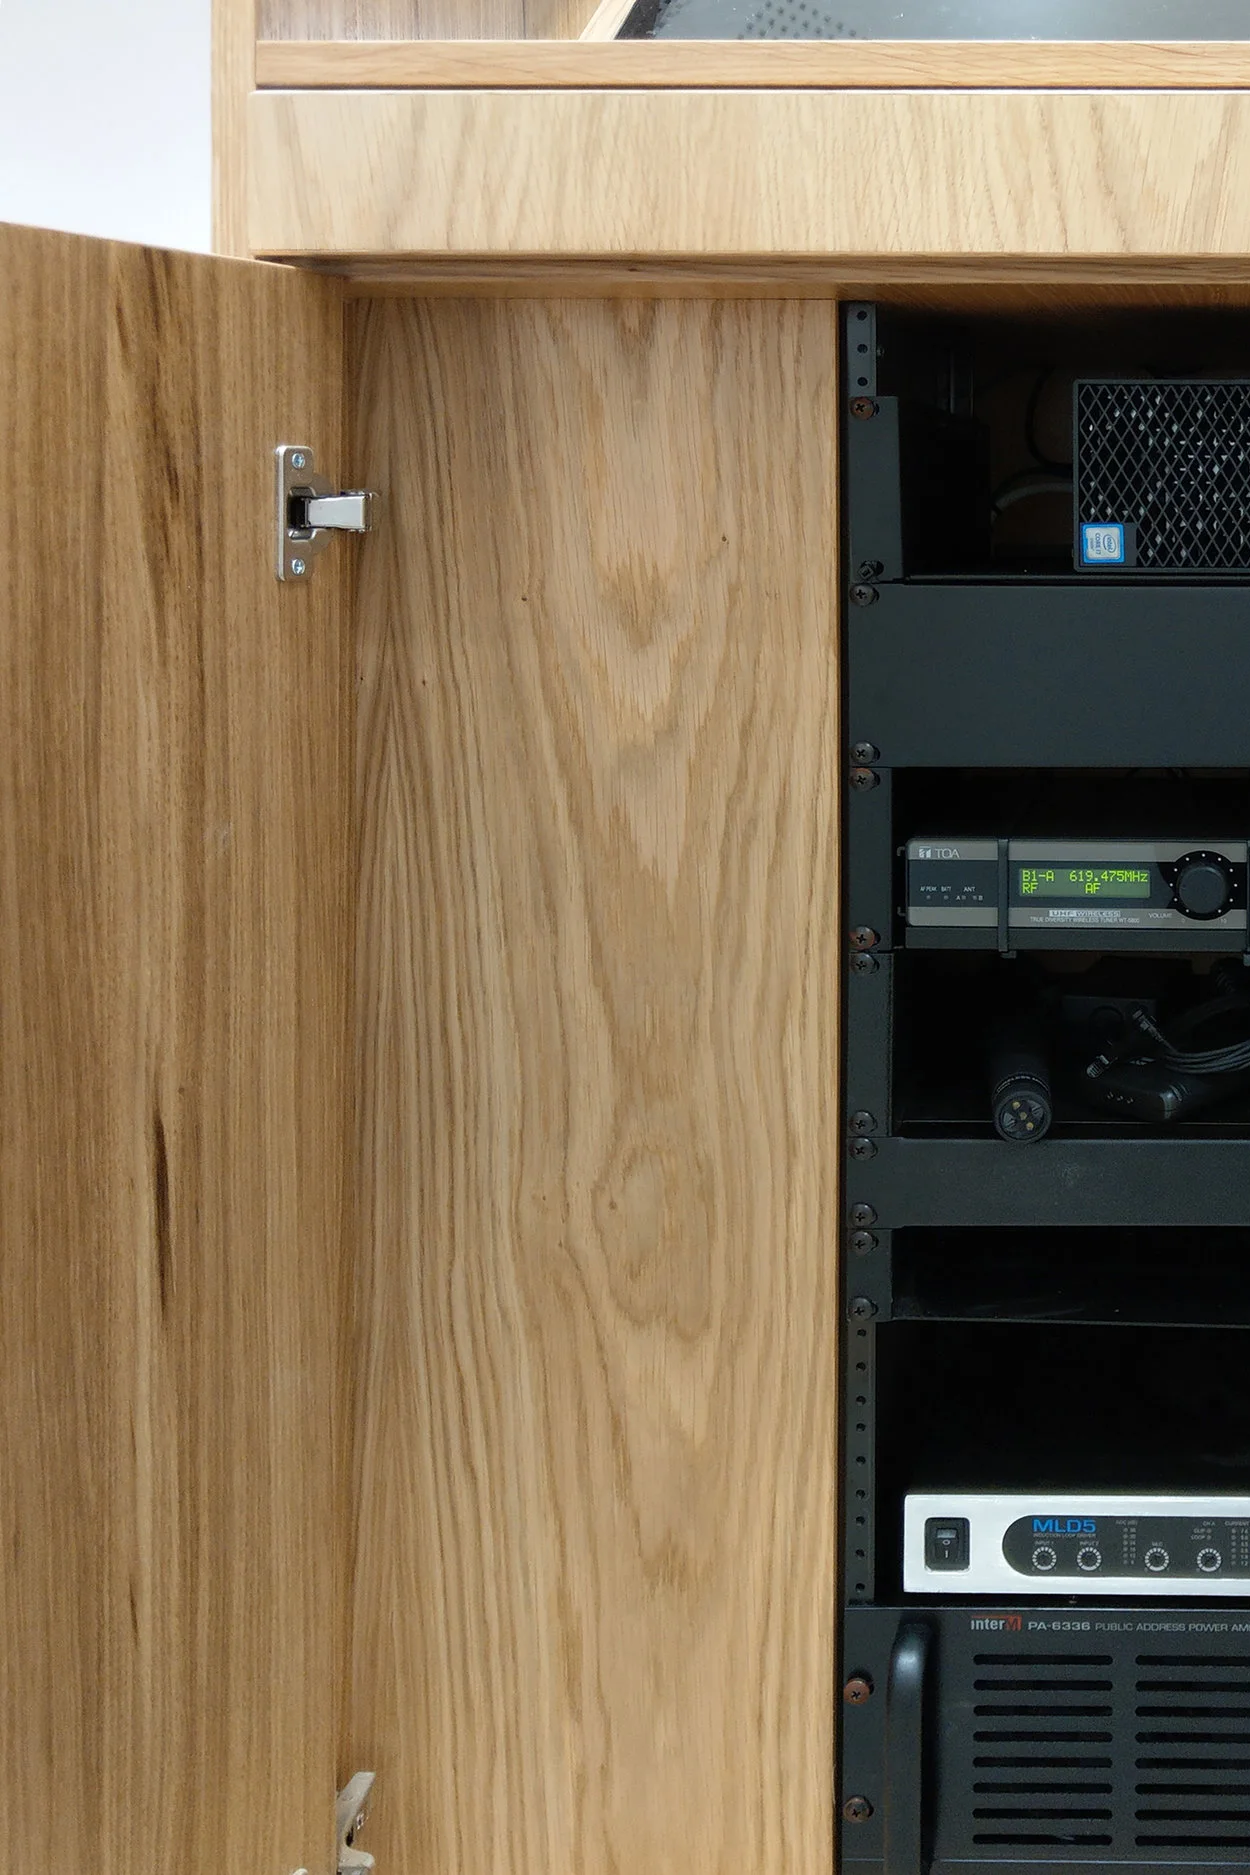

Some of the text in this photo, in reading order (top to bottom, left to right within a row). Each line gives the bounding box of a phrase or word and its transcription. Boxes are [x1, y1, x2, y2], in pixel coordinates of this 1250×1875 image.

[935, 848, 960, 859] TOA
[1022, 870, 1149, 883] B1-A 619.475MHz
[1022, 883, 1101, 894] RF AF
[1033, 1519, 1096, 1533] MLD5
[1028, 1622, 1091, 1631] PA-6336
[1095, 1622, 1133, 1632] PUBLIC
[1136, 1623, 1186, 1632] ADDRESS
[1188, 1623, 1228, 1632] POWER
